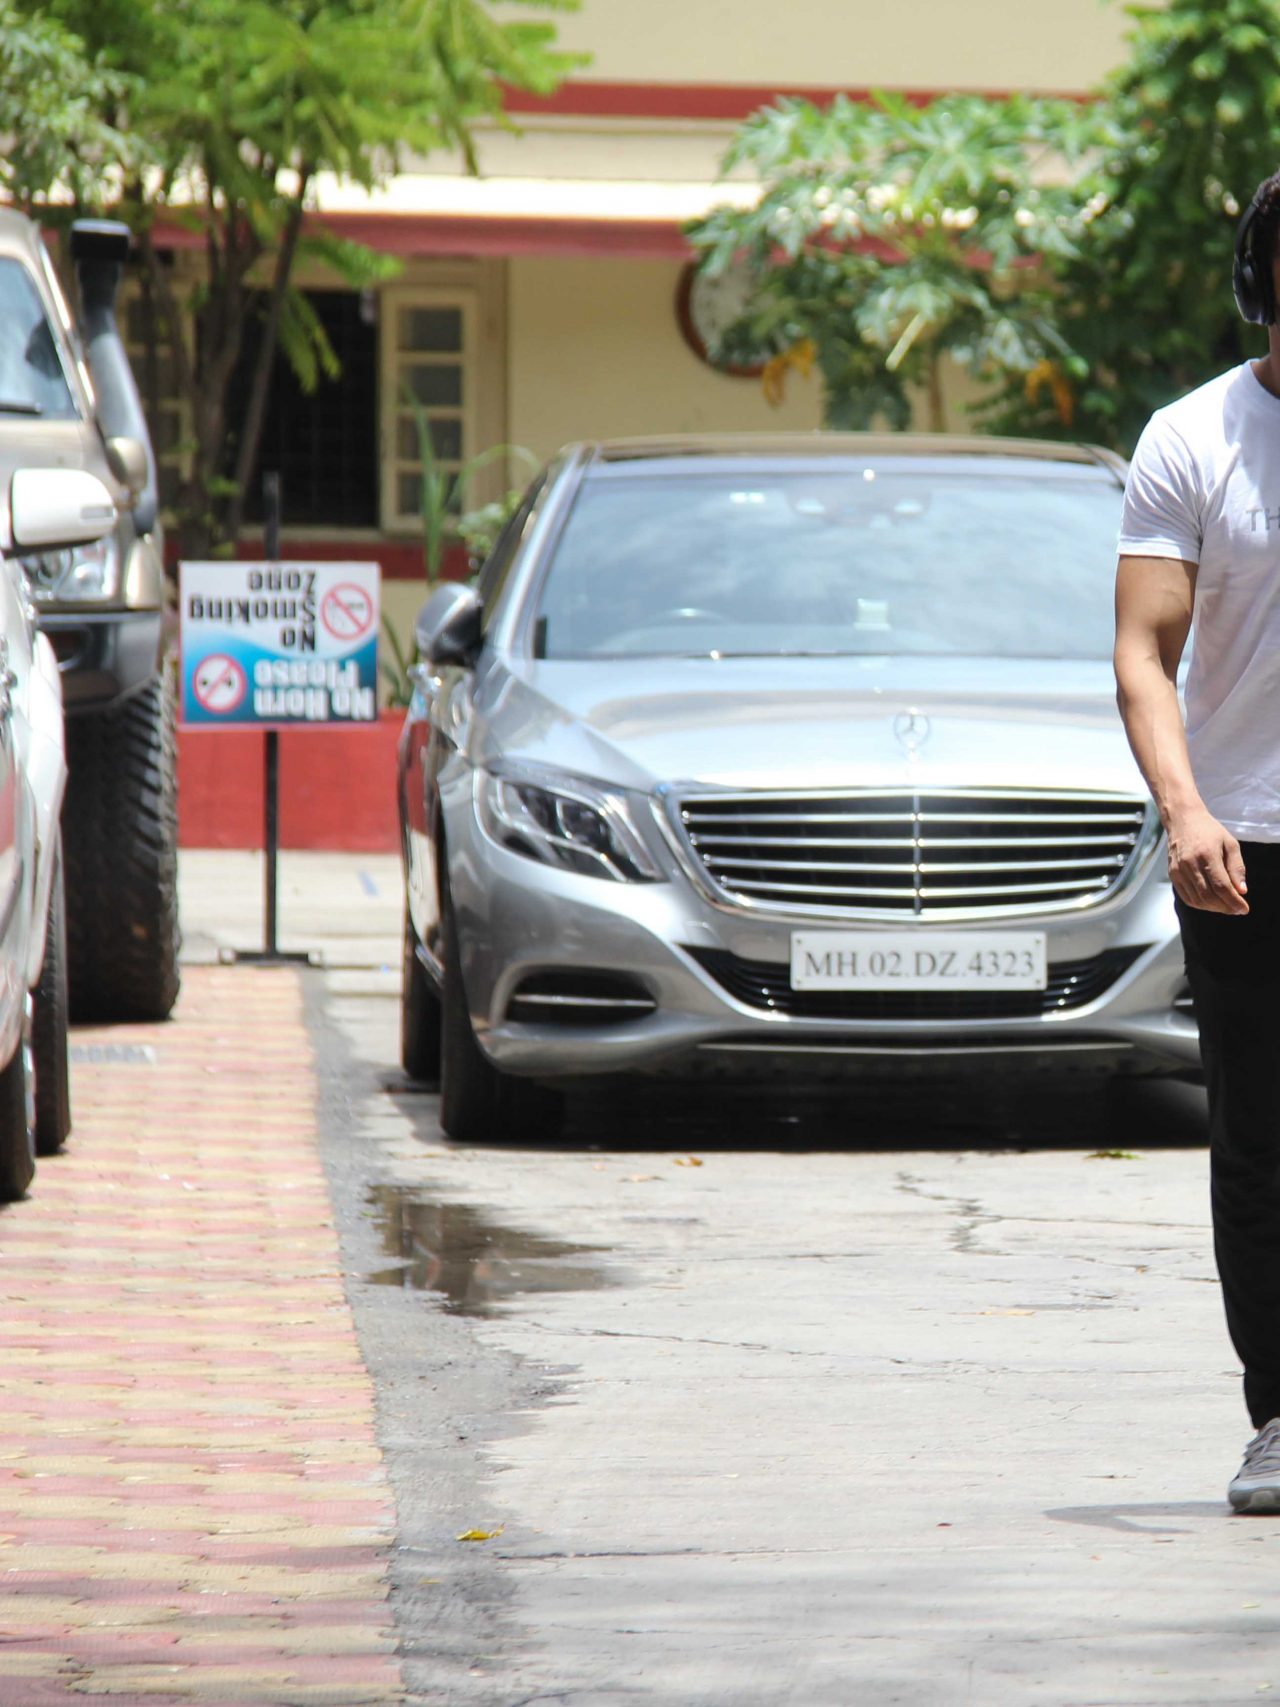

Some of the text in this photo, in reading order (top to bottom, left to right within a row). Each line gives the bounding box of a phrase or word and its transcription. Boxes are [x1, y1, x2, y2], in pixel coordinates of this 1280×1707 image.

[248, 568, 316, 594] Zone
[189, 594, 316, 624] Smoking
[281, 627, 316, 652] No
[253, 659, 359, 688] Please
[253, 687, 375, 720] No Horn
